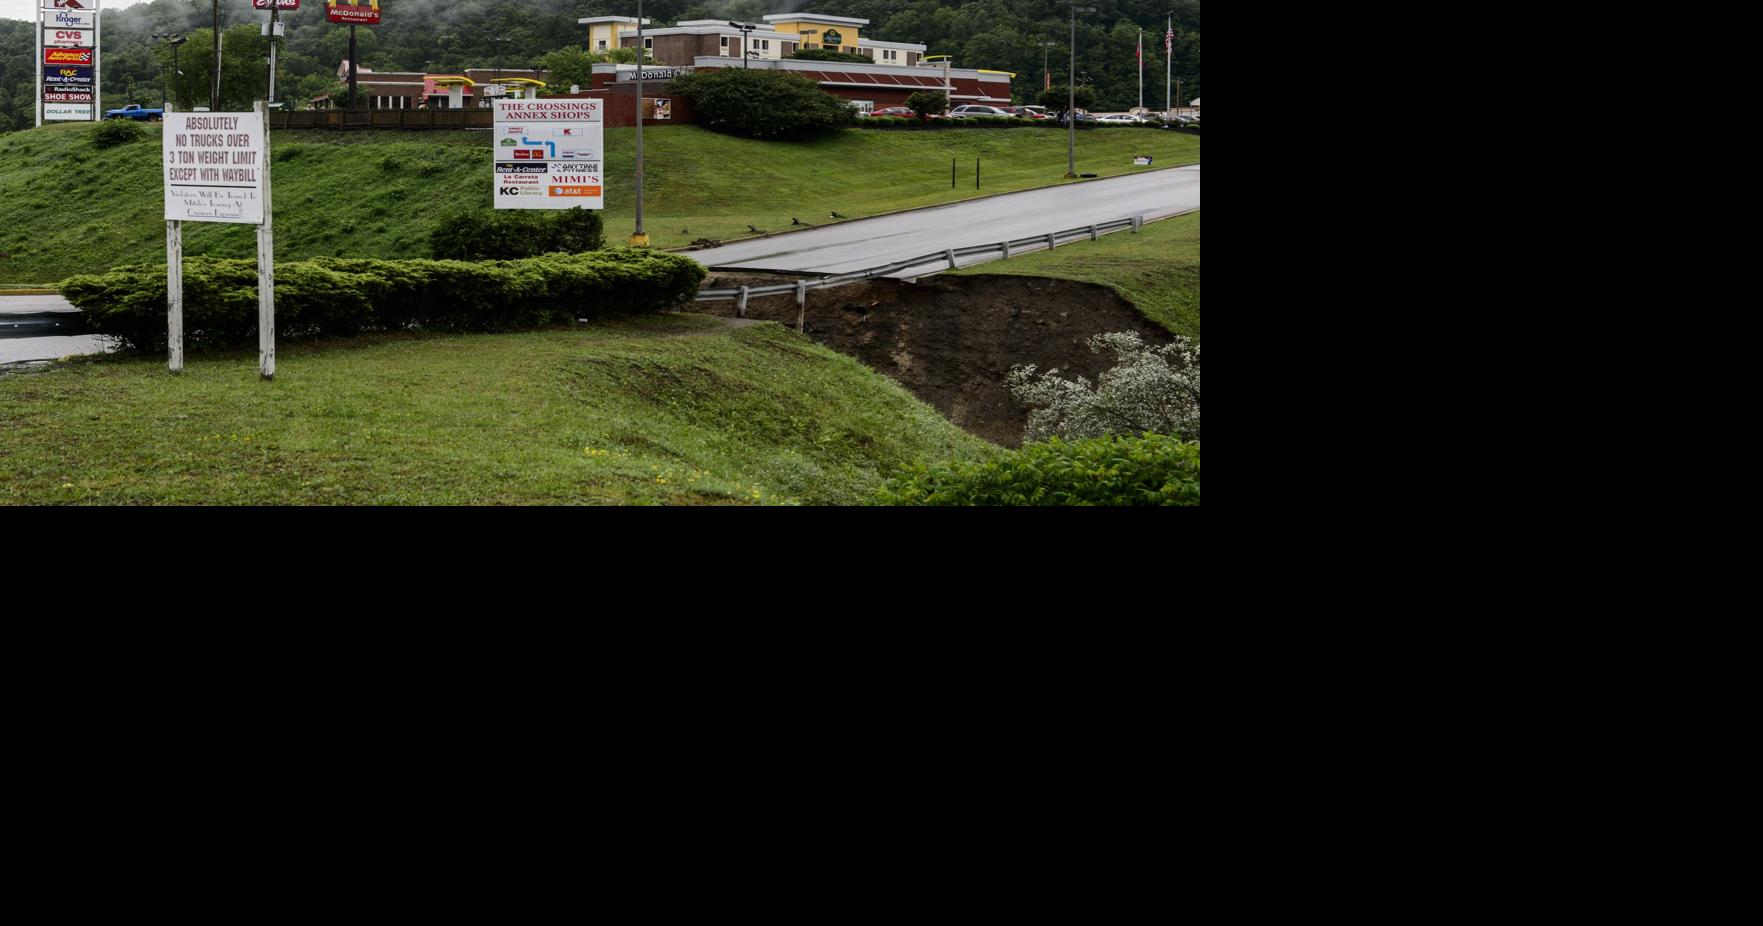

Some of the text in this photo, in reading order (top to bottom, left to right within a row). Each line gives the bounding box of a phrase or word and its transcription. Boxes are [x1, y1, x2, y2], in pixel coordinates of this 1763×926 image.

[56, 11, 81, 26] Kroger
[330, 9, 380, 18] McDonald's
[55, 31, 82, 39] CVS
[527, 103, 596, 111] CROSSINGS
[186, 117, 239, 130] ABSOLUTELY
[176, 134, 250, 147] NO TRUCKS OVER
[169, 151, 257, 165] 3 TON WEIGHT LIMIT
[169, 168, 256, 182] EXCEPT WITH WAYBILL
[198, 190, 213, 198] Will
[500, 187, 519, 195] KC
